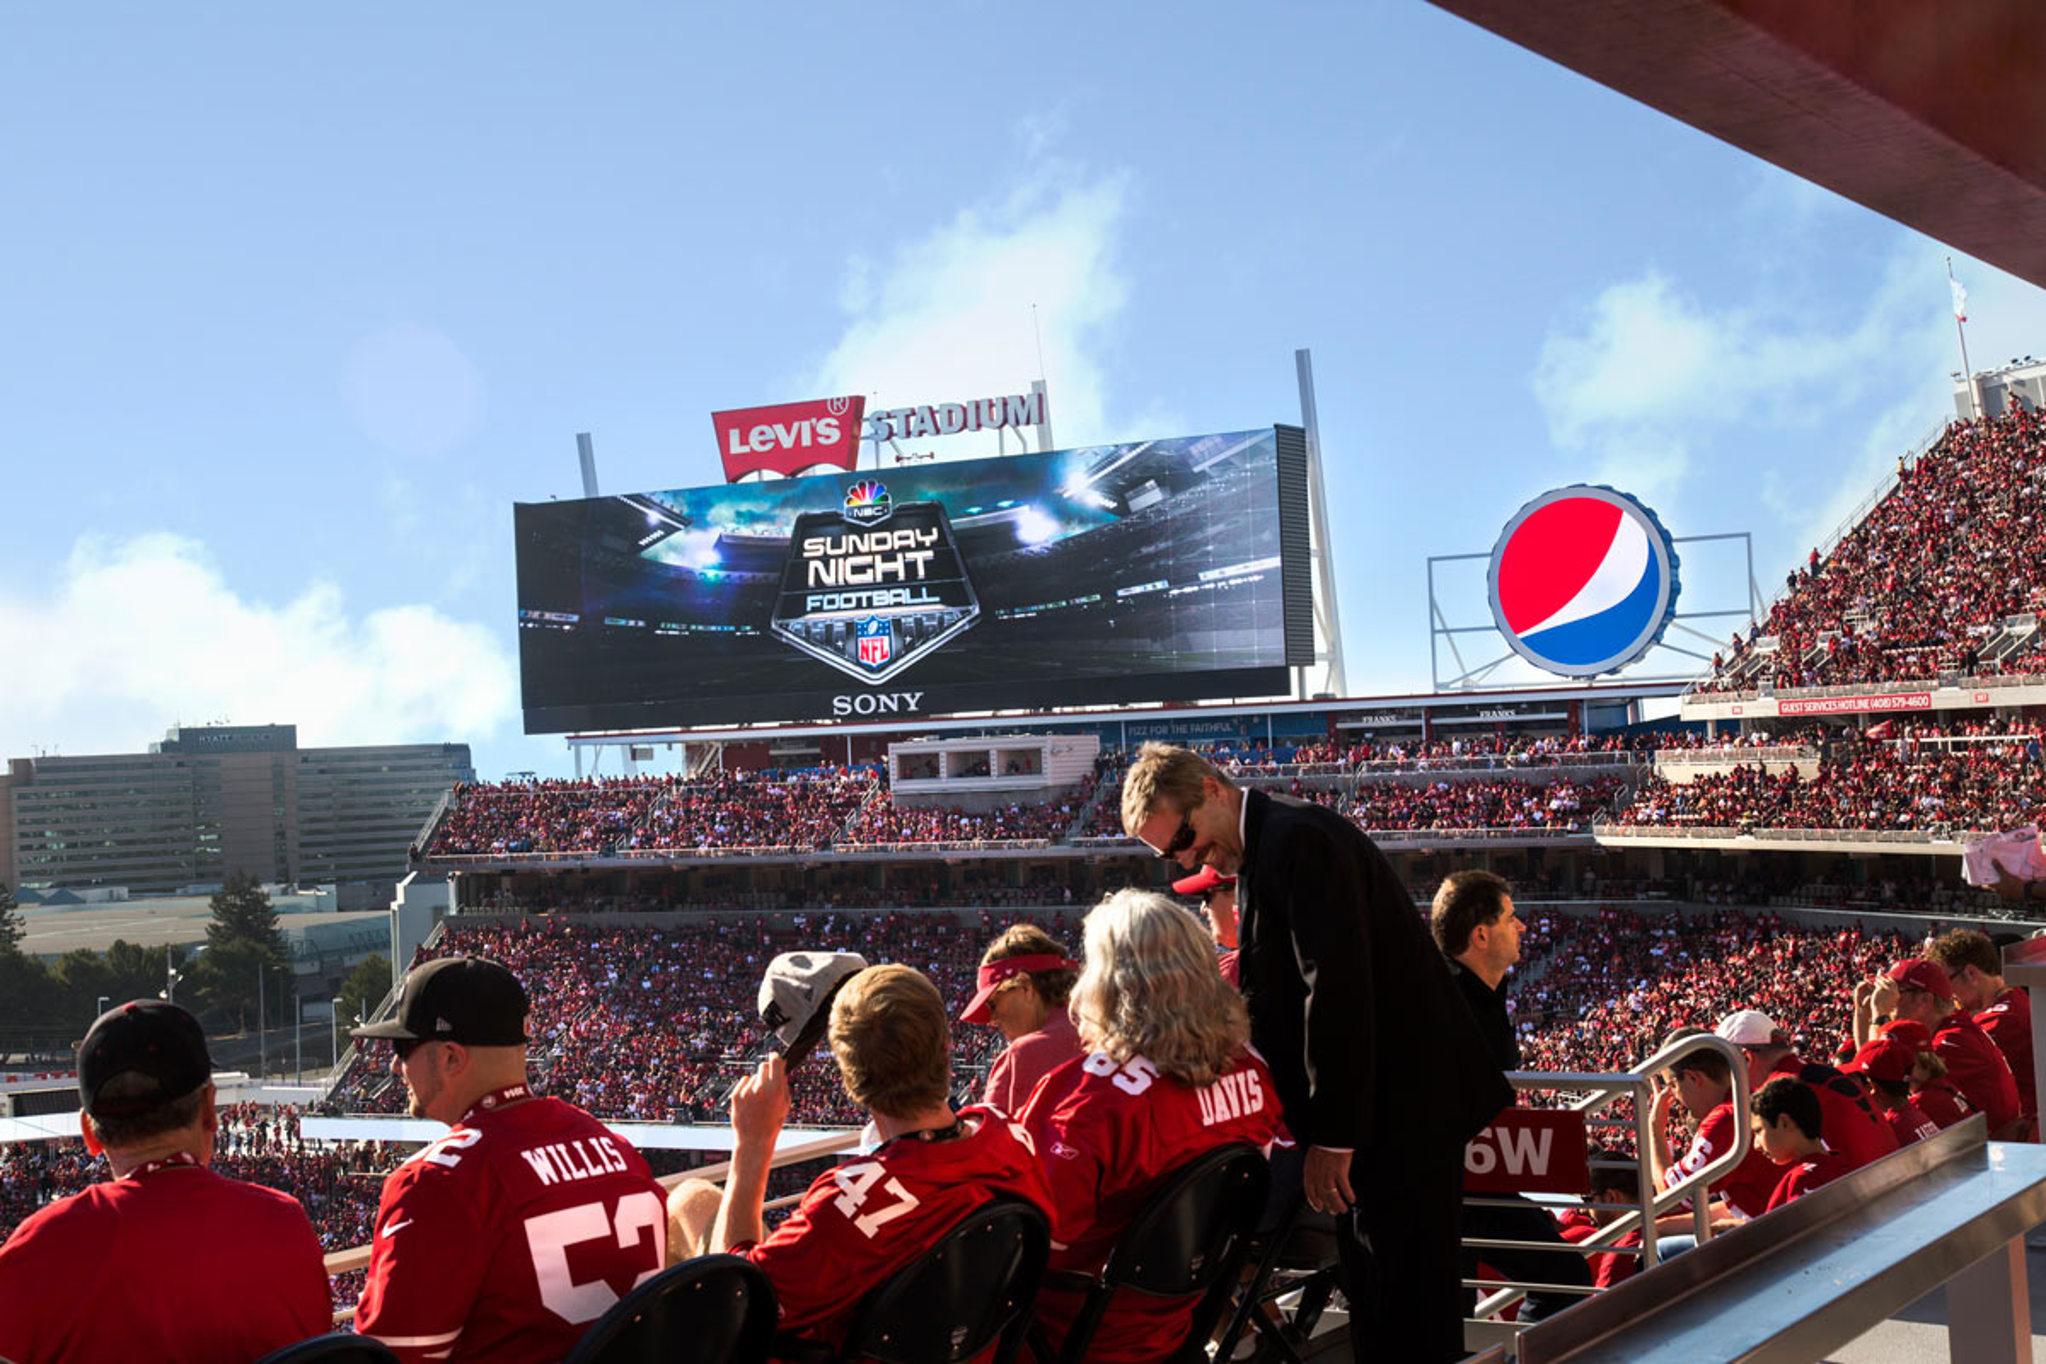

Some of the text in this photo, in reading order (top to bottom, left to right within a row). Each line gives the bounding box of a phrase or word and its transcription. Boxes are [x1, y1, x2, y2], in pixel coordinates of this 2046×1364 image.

[868, 392, 1044, 442] STADIUM
[853, 506, 884, 518] NBC
[802, 527, 939, 559] SUNDAY
[807, 550, 935, 588] NIGHT
[806, 587, 941, 612] FOOTBALL
[858, 635, 889, 667] NFL
[832, 692, 924, 716] SONY
[1781, 702, 1802, 714] GUEST
[1171, 724, 1188, 735] THE
[1196, 1068, 1264, 1127] DAVIS
[520, 1136, 628, 1187] WILLIS
[833, 1161, 921, 1239] 47
